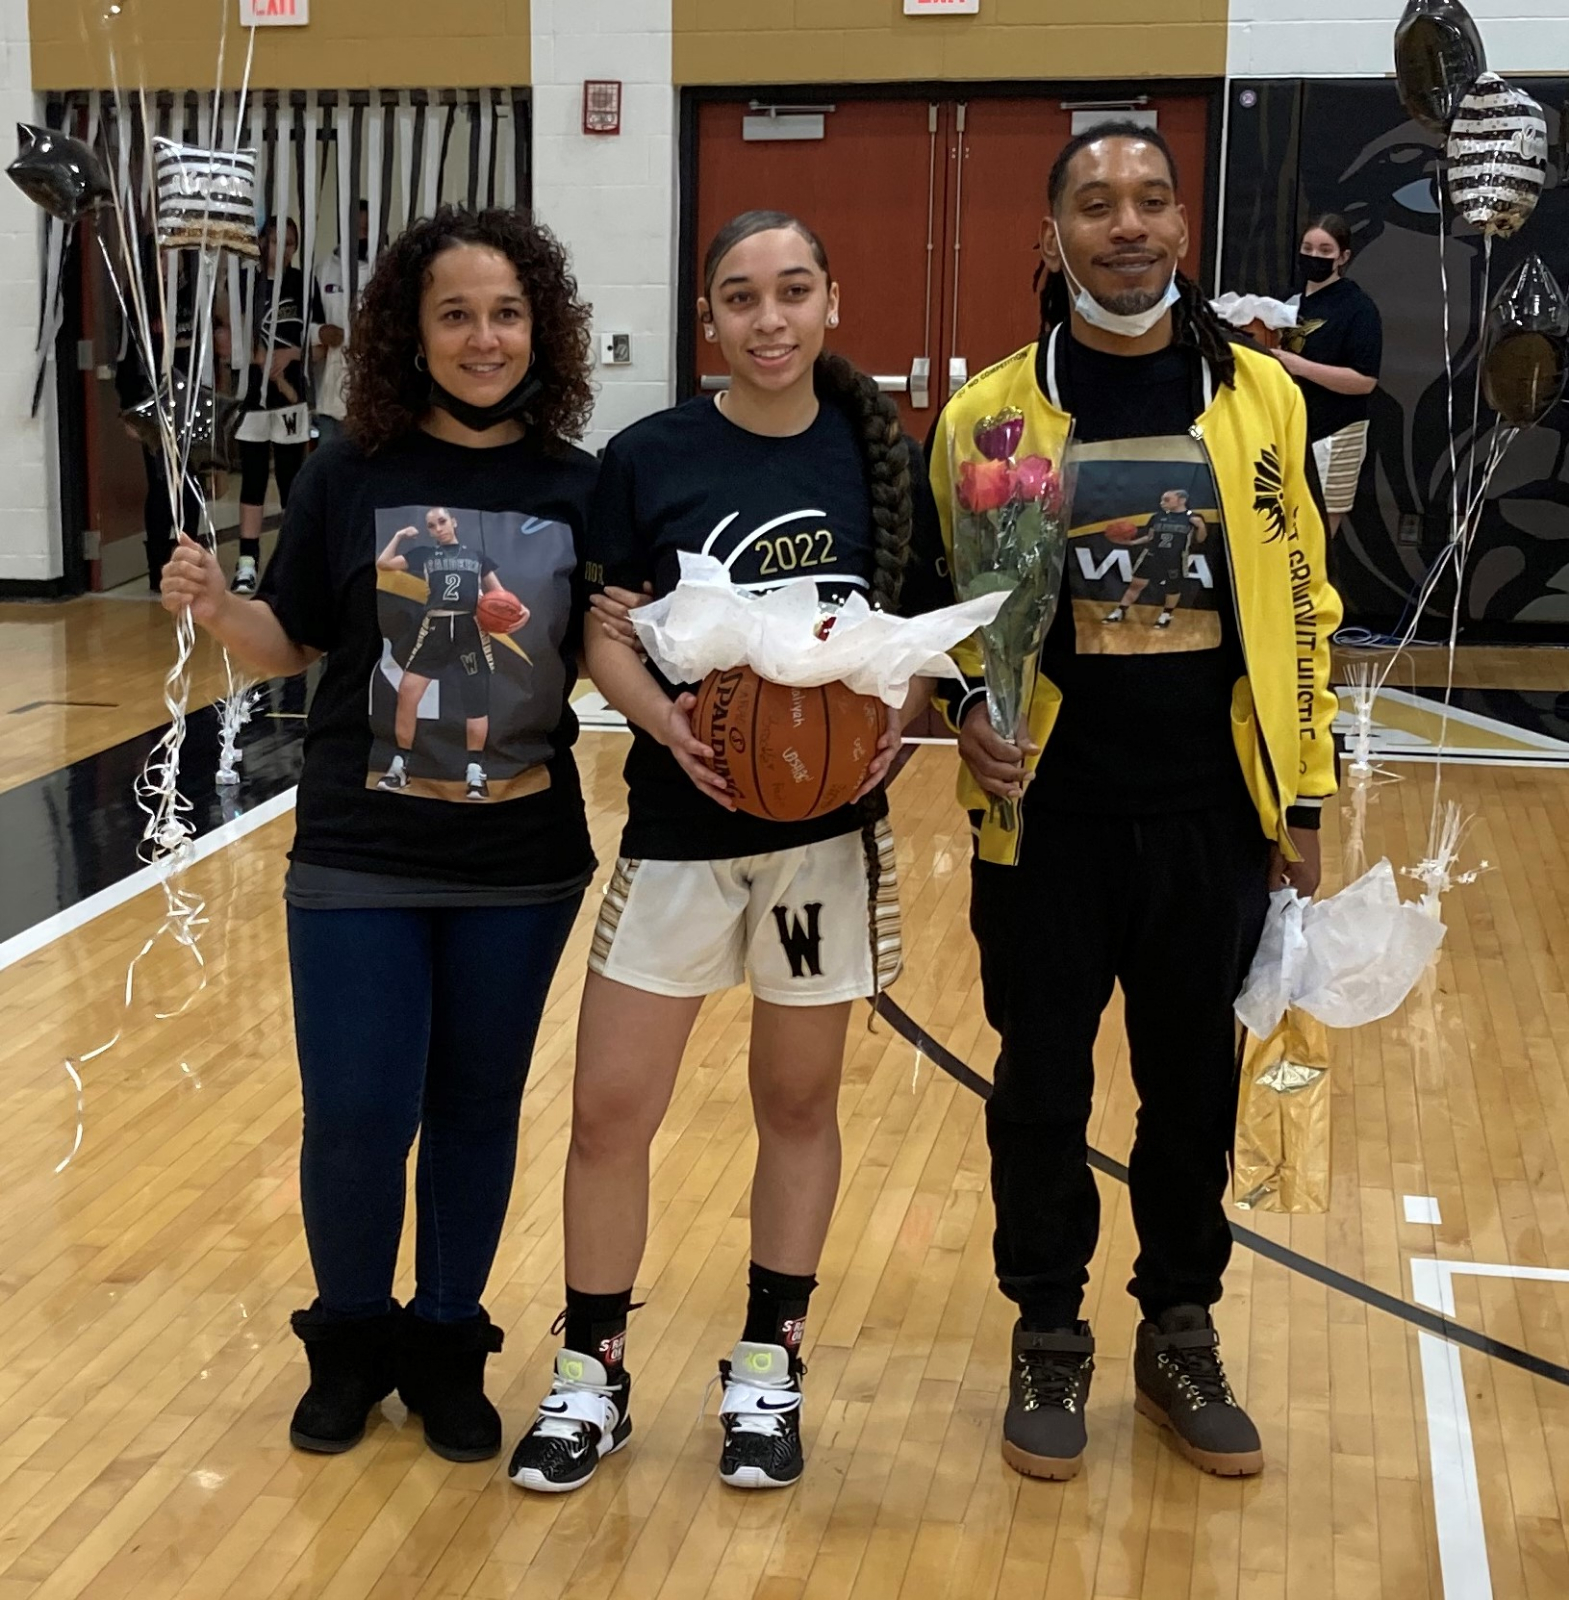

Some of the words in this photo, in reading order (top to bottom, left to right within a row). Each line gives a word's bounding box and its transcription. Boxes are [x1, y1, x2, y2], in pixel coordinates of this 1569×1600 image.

[282, 412, 297, 435] W
[754, 529, 838, 576] 2022
[442, 573, 461, 601] 2
[771, 902, 823, 978] W
